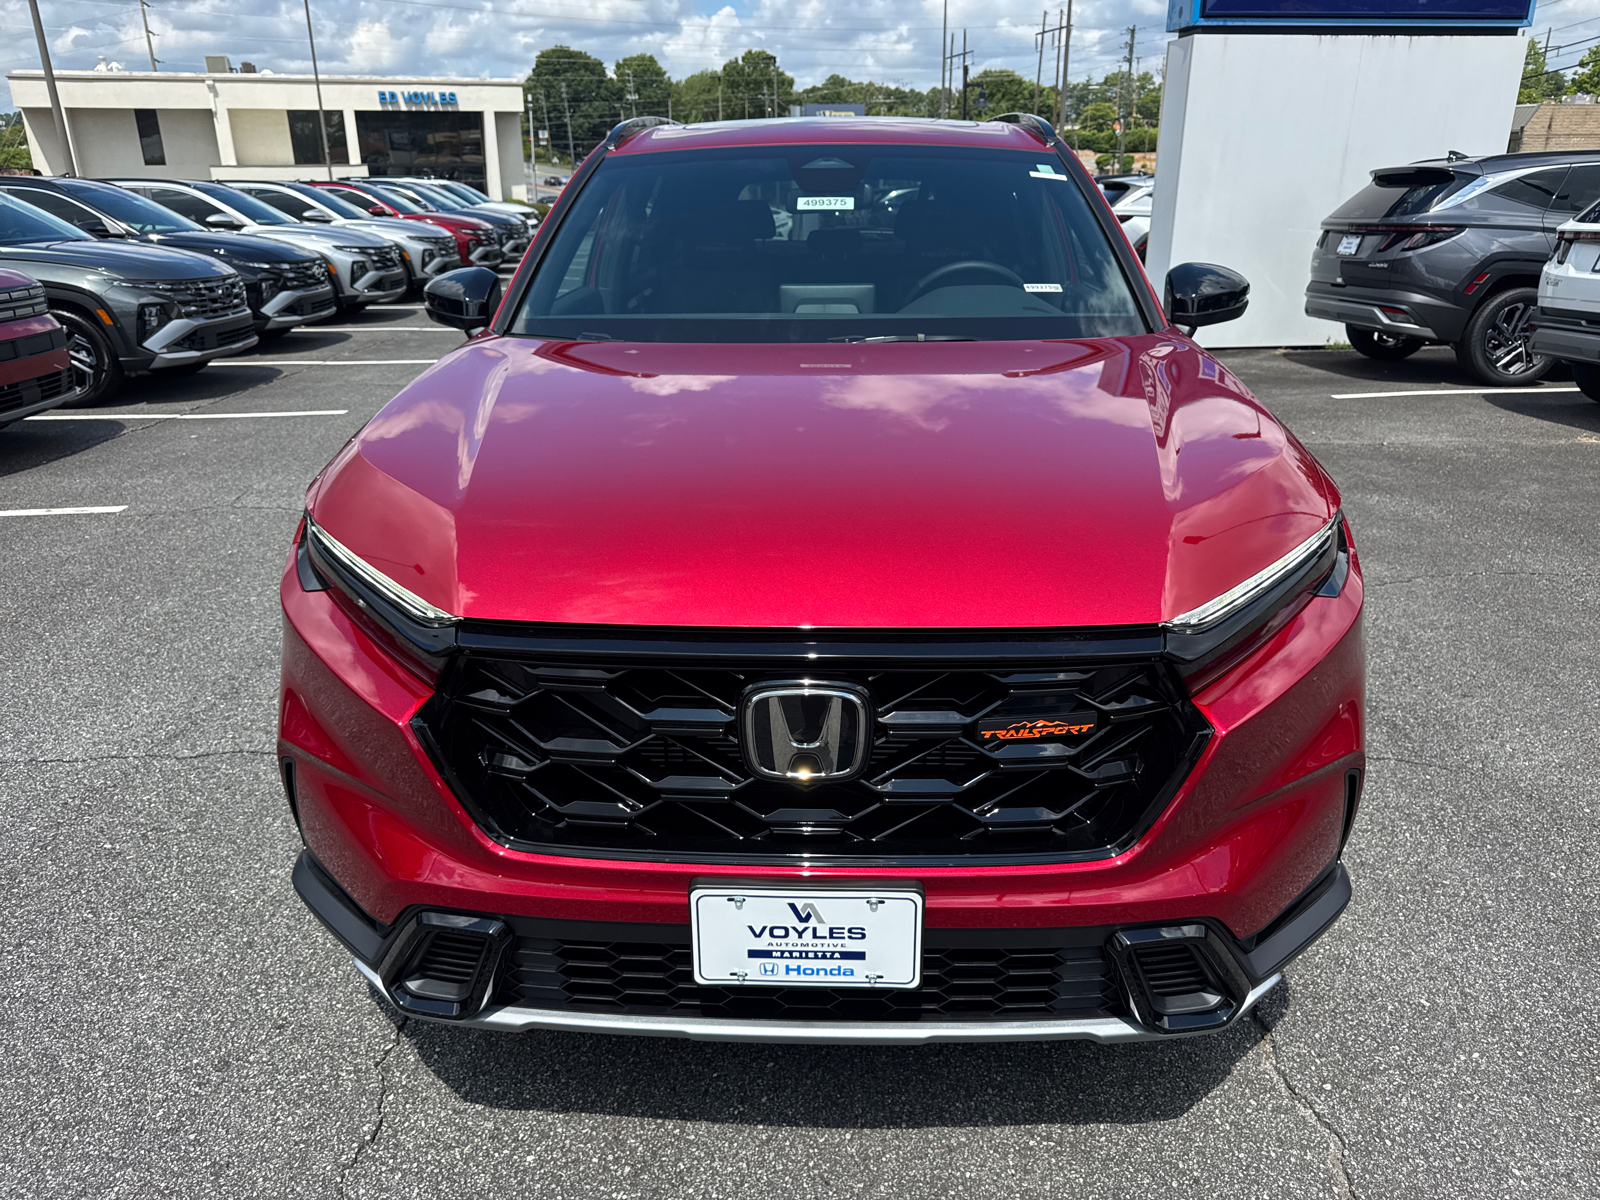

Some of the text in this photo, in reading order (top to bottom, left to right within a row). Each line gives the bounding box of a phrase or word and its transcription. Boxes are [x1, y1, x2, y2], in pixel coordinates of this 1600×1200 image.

[378, 91, 458, 104] ED VOYLES
[803, 198, 847, 207] 499375
[981, 724, 1094, 739] TRAILSPORT
[747, 925, 867, 940] VOYLES
[772, 950, 842, 959] MARIETTA
[785, 964, 855, 977] Honda
